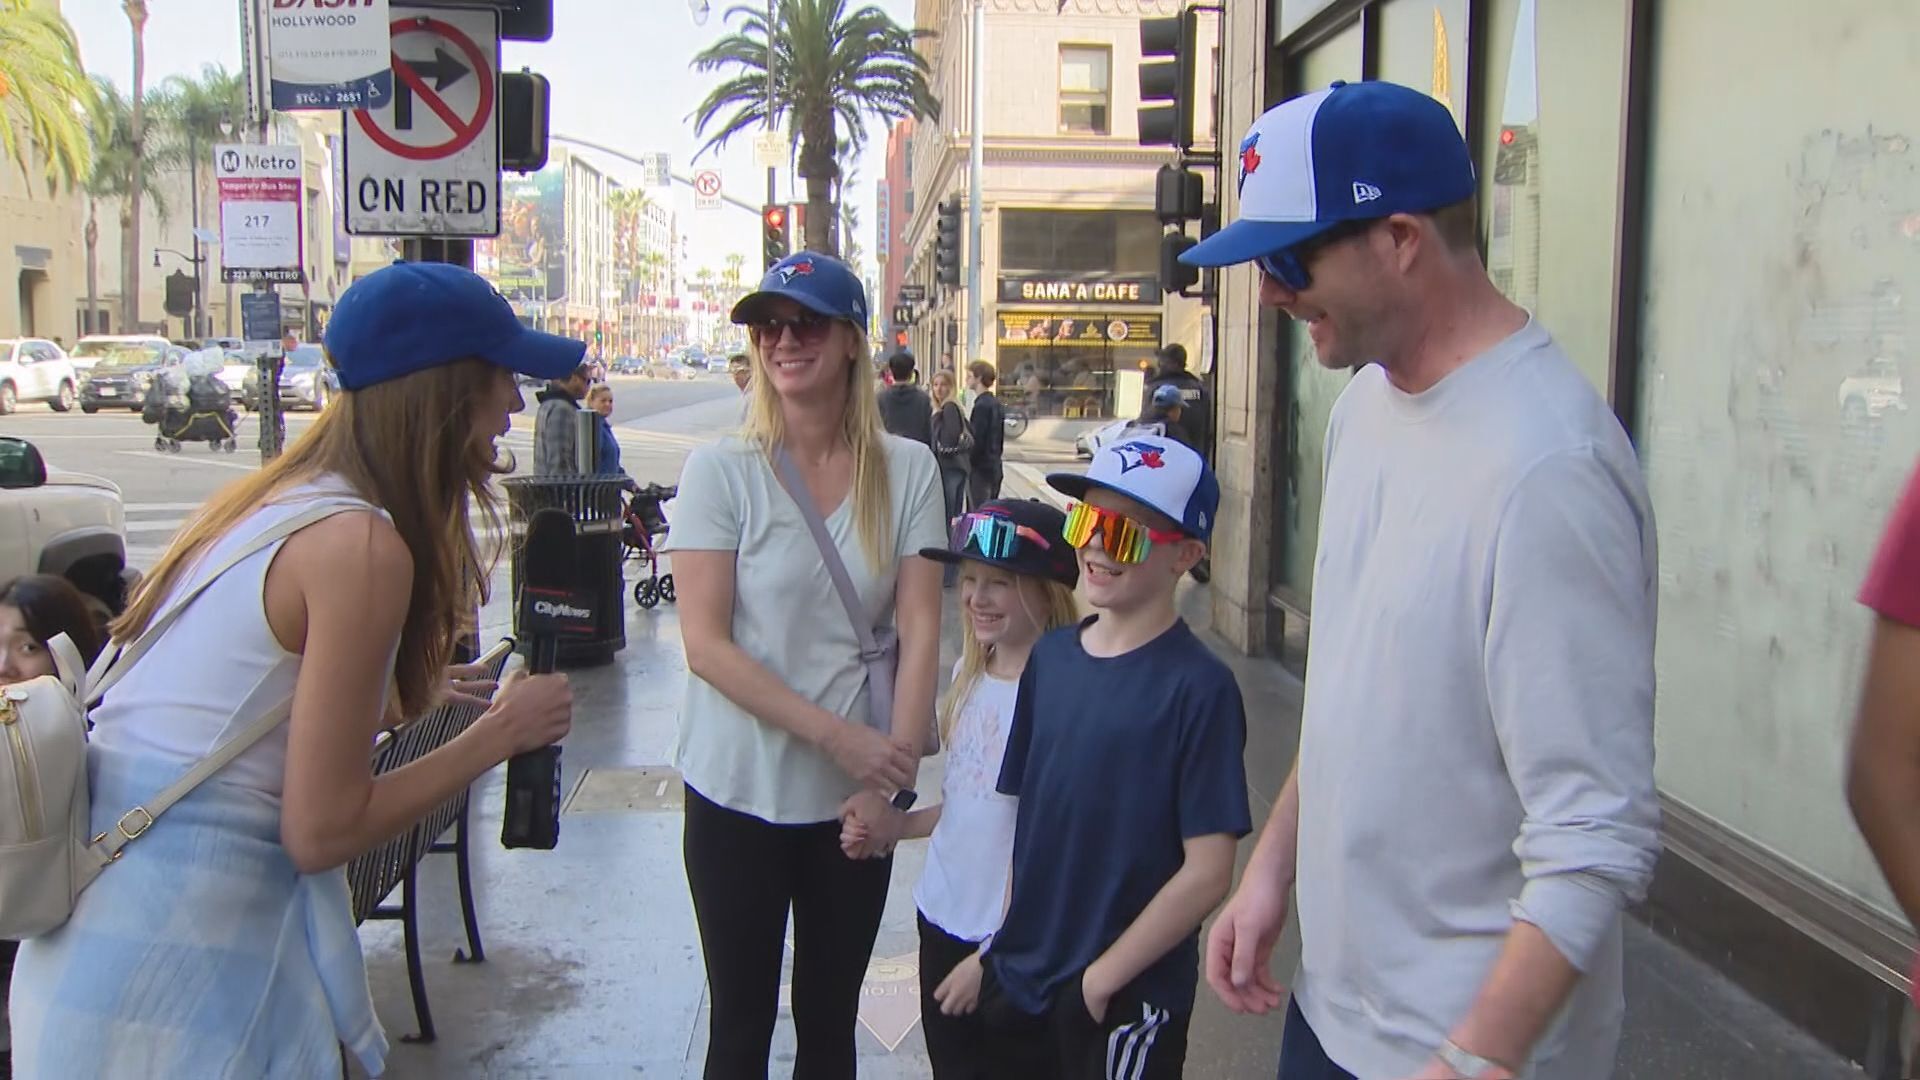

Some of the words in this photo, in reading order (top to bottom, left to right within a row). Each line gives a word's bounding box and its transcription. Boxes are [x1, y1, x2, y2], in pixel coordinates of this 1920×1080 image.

[272, 15, 357, 28] HOLLYWOOD
[246, 154, 296, 169] Metro
[359, 176, 404, 212] ON
[421, 179, 487, 213] RED
[244, 215, 270, 228] 217
[1022, 281, 1088, 299] SANA'A
[1094, 283, 1140, 300] CAFE
[534, 600, 592, 618] CityNews
